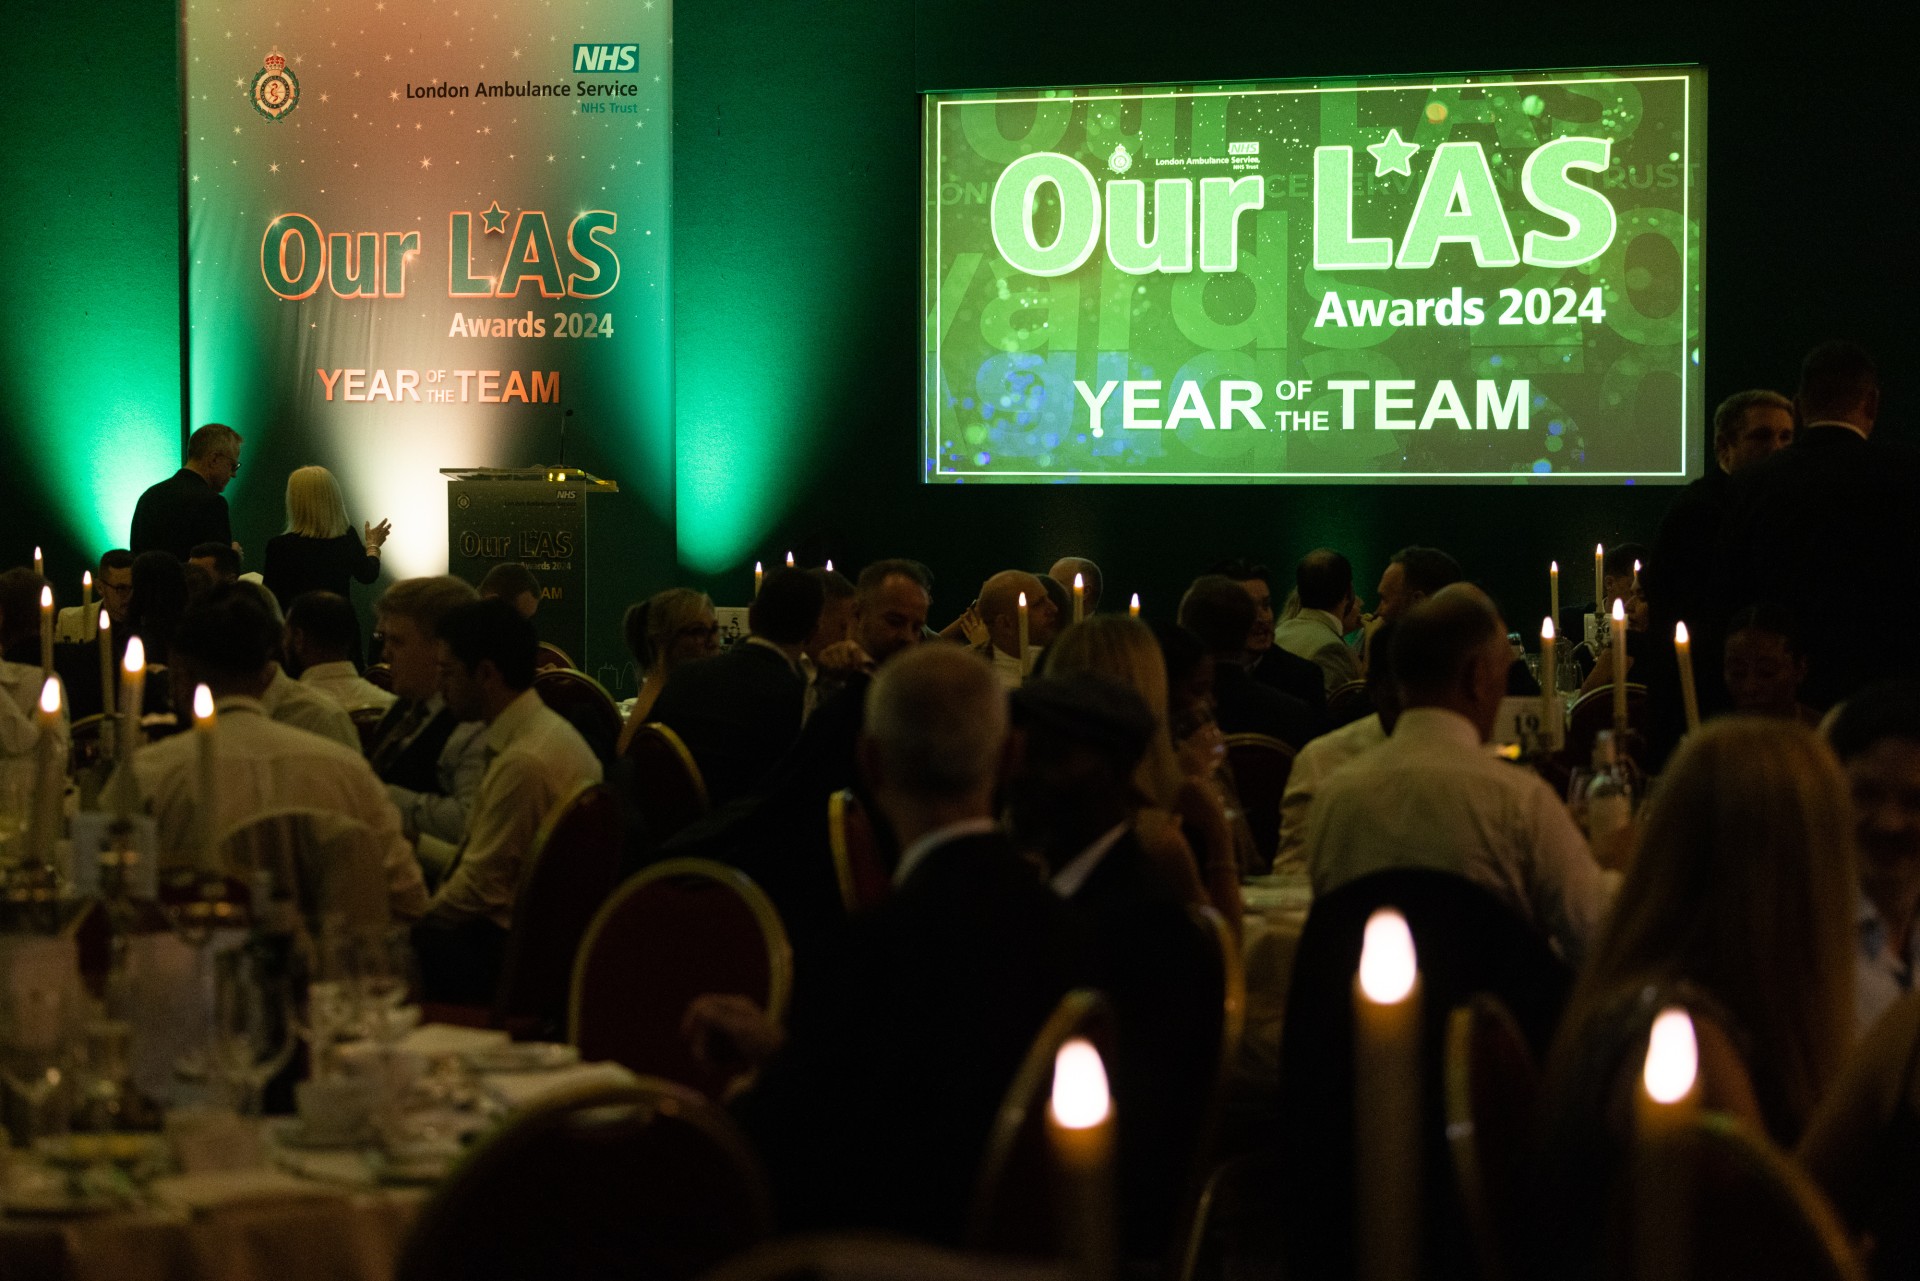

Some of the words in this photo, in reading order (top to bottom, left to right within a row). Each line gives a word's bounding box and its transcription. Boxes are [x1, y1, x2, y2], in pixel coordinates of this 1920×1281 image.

[575, 45, 637, 71] NHS
[406, 82, 469, 98] London
[474, 80, 571, 98] Ambulance
[576, 80, 638, 97] Service
[581, 102, 605, 113] NHS
[609, 102, 638, 113] Trust
[1230, 143, 1258, 153] NHS
[1155, 158, 1184, 166] London
[1186, 157, 1229, 165] Ambulance
[990, 151, 1265, 277] Our
[1313, 136, 1617, 271] LAS
[261, 212, 420, 300] Our
[448, 210, 620, 299] LAS
[1313, 286, 1485, 328] Awards
[1498, 286, 1606, 326] 2024
[448, 311, 546, 338] Awards
[553, 312, 614, 338] 2024
[317, 368, 421, 402] YEAR
[426, 369, 446, 383] OF
[453, 369, 560, 403] TEAM
[426, 389, 454, 403] THE
[1275, 379, 1313, 401] OF
[1072, 379, 1267, 431] YEAR
[1327, 379, 1530, 430] TEAM
[1275, 410, 1330, 431] THE
[556, 490, 577, 499] NHS
[460, 530, 511, 558] Our
[519, 530, 573, 558] LAS
